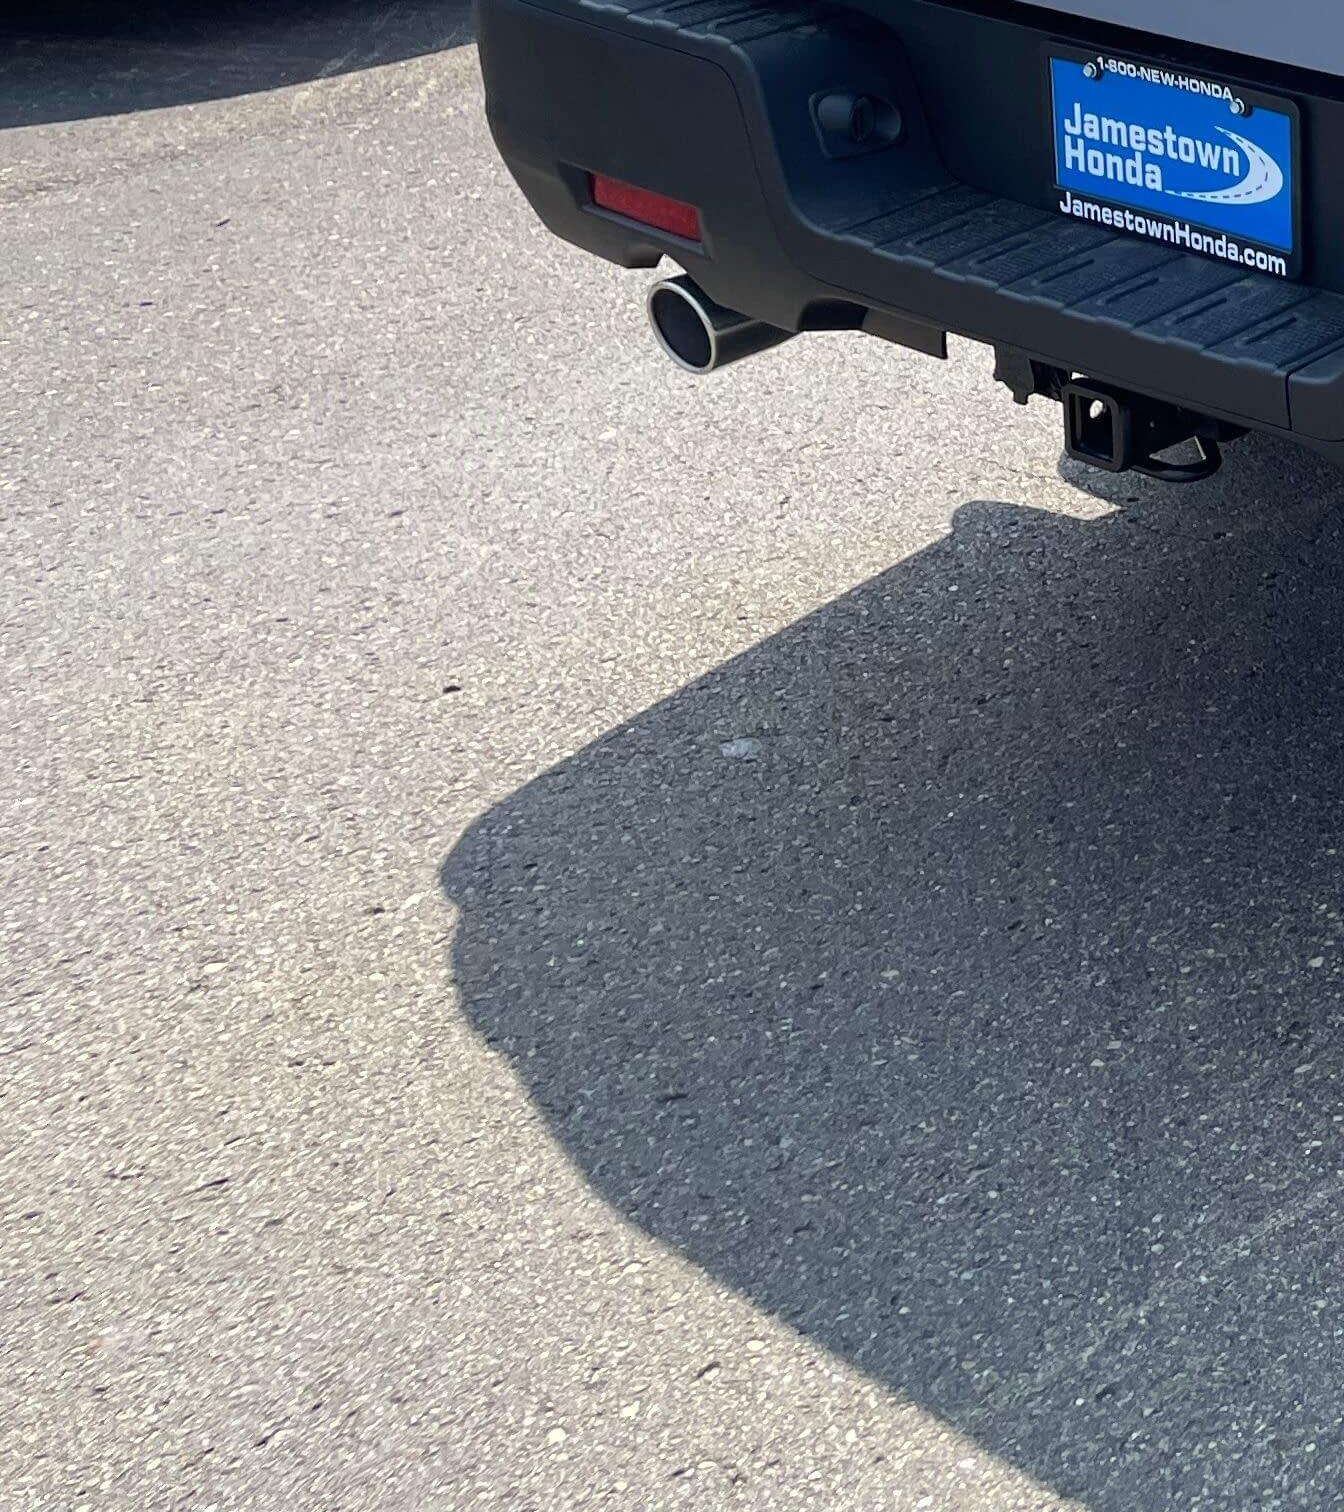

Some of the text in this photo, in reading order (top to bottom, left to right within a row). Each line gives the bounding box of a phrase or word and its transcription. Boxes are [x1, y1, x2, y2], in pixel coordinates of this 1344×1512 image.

[1096, 56, 1233, 102] 1-800-NEW-HONDA
[1064, 102, 1240, 177] Jamestown
[1064, 135, 1163, 192] Honda
[1059, 191, 1287, 277] JamestownHonda.com
